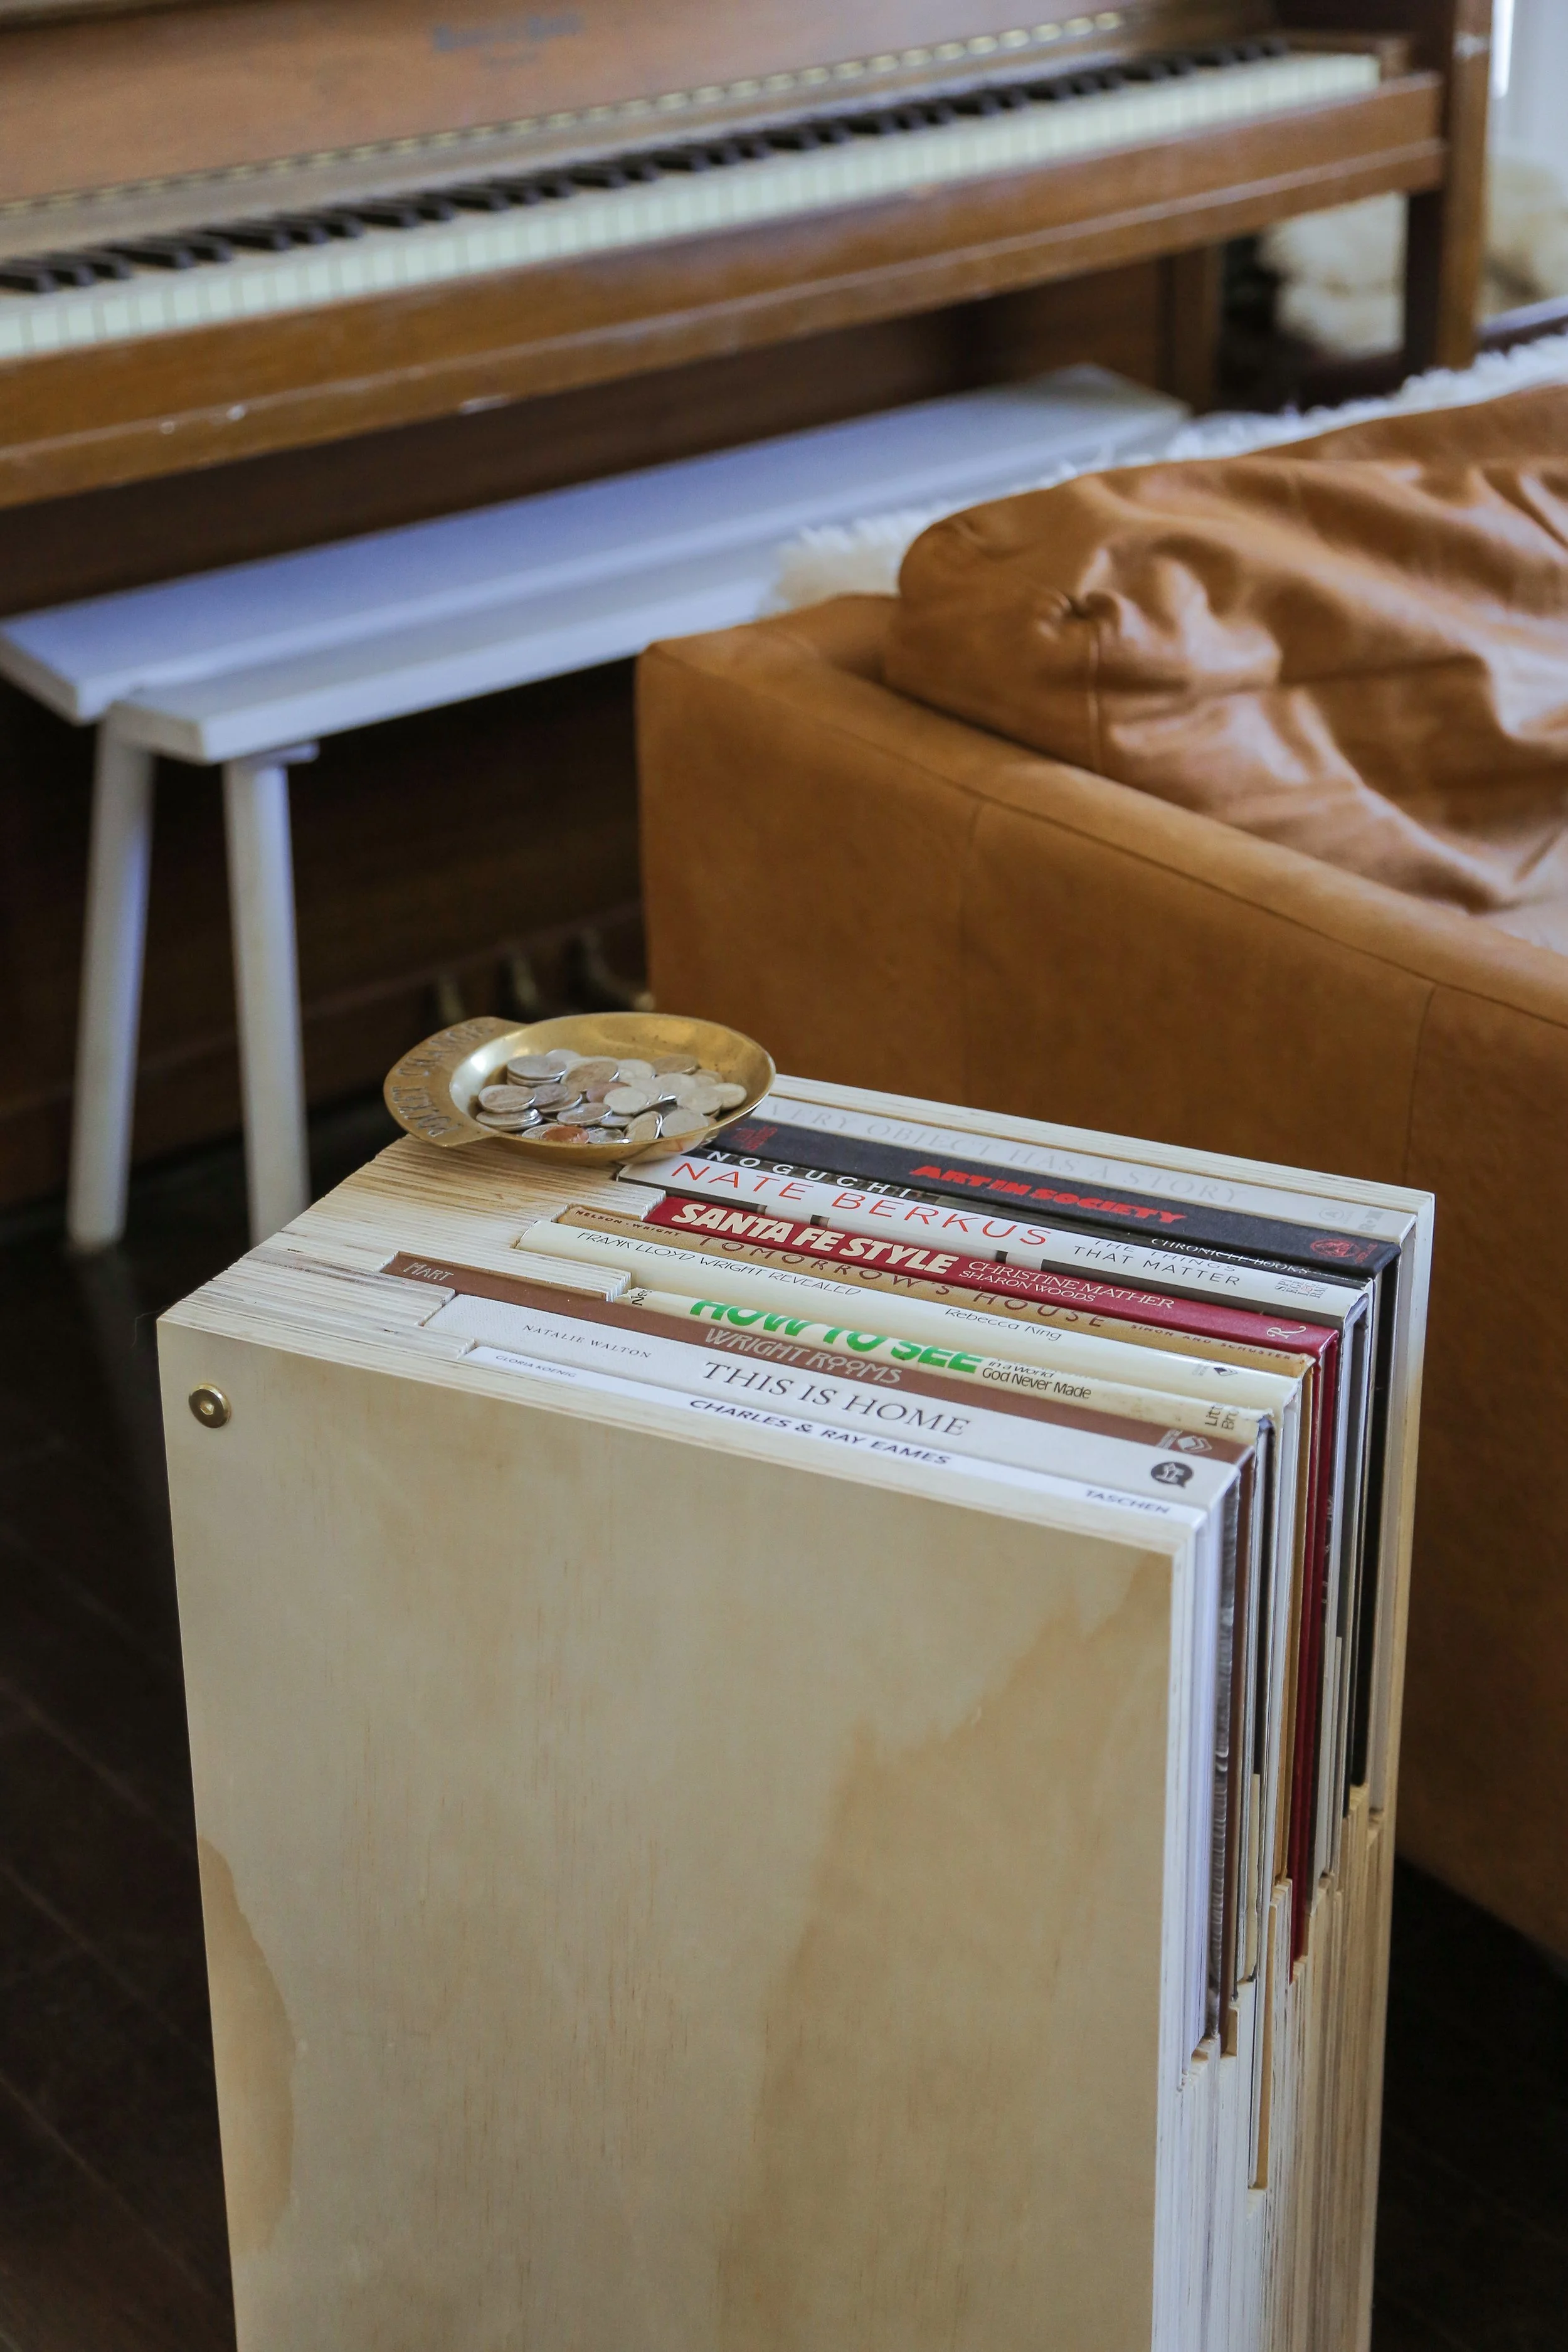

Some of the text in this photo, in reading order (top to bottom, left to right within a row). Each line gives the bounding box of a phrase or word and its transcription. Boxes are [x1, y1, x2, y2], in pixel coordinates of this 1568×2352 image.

[766, 1101, 1249, 1202] VERY OBJECT HAS A STORY
[707, 1151, 911, 1198] NOGUCHI
[909, 1165, 1187, 1223] ART IN SOCIETY
[575, 1210, 682, 1237] NELSON WRIGHT
[671, 1162, 1051, 1245] NATE BERKUS
[671, 1203, 960, 1274] SANTA FE STYLE
[1094, 1240, 1238, 1272] THE THINGS
[403, 1262, 454, 1281] HART
[577, 1231, 861, 1296] FRANK LLOYD WRIGHT REVEALED
[699, 1236, 1106, 1327] TOMORROW'S HOUSE
[1074, 1246, 1241, 1285] THAT MATTER
[1253, 1258, 1310, 1274] BOOKS
[958, 1269, 1096, 1303] SHARON WOODS
[968, 1261, 1175, 1310] CHRISTINE MATHER
[522, 1324, 652, 1359] NATALIE WALTON
[690, 1299, 985, 1374] HOW TO SEE
[945, 1308, 1063, 1342] Rebecca King
[1130, 1324, 1291, 1360] SIMON AND SCHUSTER
[495, 1355, 577, 1378] GLORIA KOENIG
[705, 1328, 904, 1384] WRIGHT ROOMS
[702, 1362, 971, 1436] THIS IS HOME
[982, 1367, 1092, 1399] God Never Made
[690, 1400, 951, 1465] CHARLES & RAY EAMES
[1086, 1489, 1170, 1514] TASCHEN
